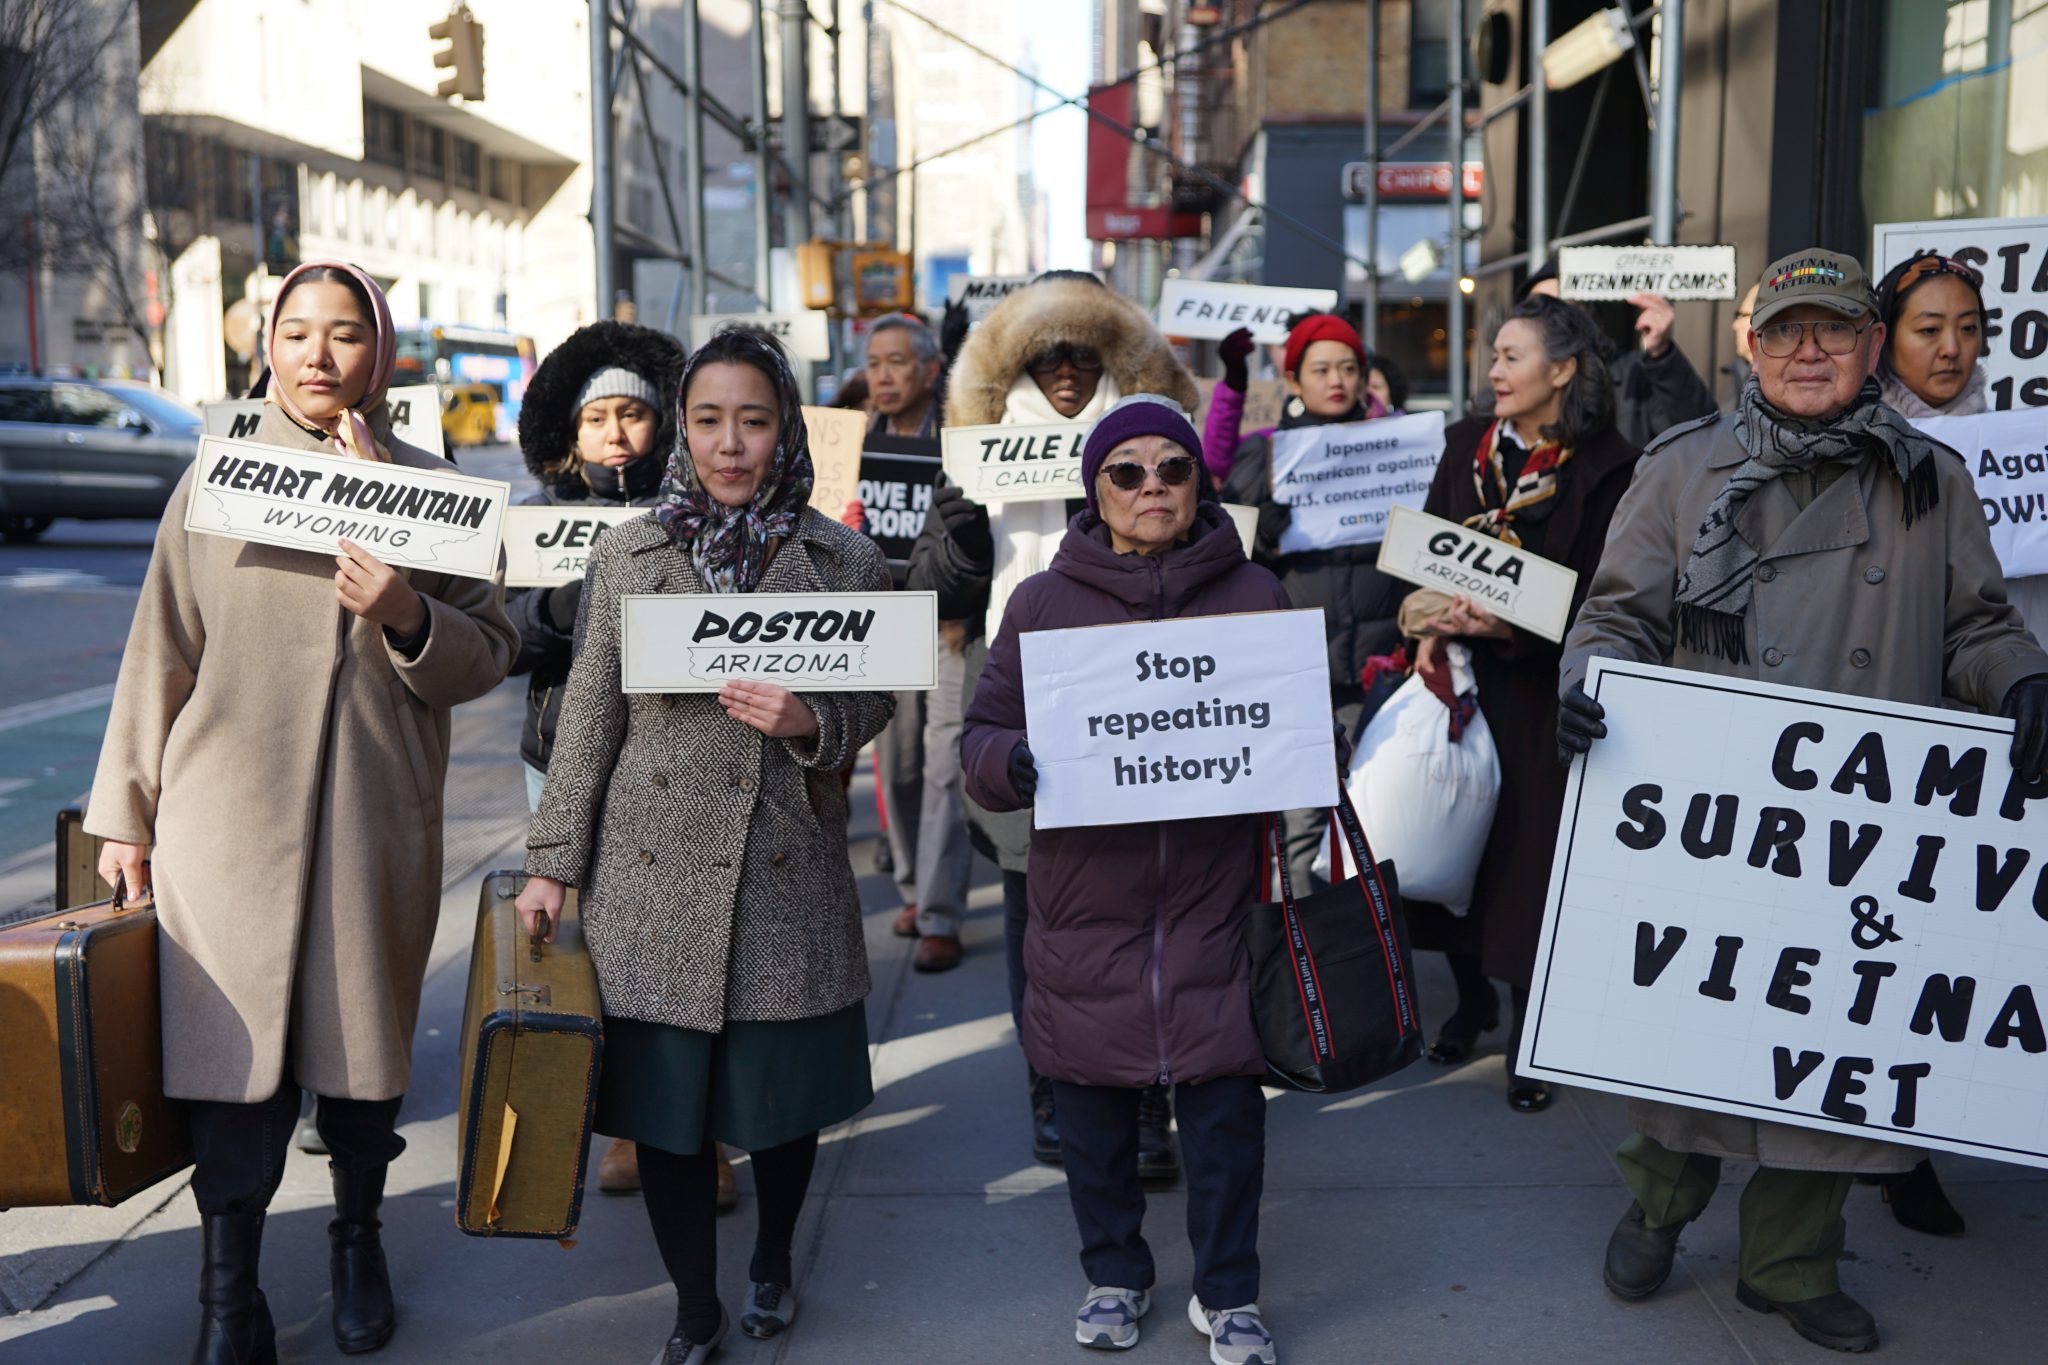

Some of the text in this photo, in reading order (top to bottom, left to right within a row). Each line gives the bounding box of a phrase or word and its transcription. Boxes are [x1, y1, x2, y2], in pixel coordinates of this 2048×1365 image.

[1616, 253, 1674, 267] OTHER
[1777, 258, 1838, 275] VIETNAM
[1567, 272, 1728, 291] INTERNMENT CAMPS
[1775, 276, 1838, 293] VETERAN
[980, 435, 1062, 463] TULE
[1325, 437, 1399, 458] Japanese
[1286, 454, 1437, 485] Americans against
[207, 455, 492, 529] HEART MOUNTAIN
[1289, 493, 1319, 507] U.S.
[263, 508, 411, 547] WYOMING
[1340, 510, 1391, 527] camp
[1428, 531, 1524, 586] GILA
[1424, 562, 1510, 605] ARIZONA
[691, 609, 876, 643] POSTON
[706, 654, 849, 673] ARIZONA
[1136, 650, 1216, 683] Stop
[1088, 698, 1270, 740] repeating
[1114, 747, 1252, 786] history!
[1351, 831, 1372, 874] THIRTEEN
[1616, 783, 2048, 922] SURVIV
[1368, 879, 1387, 923] THIRTEEN
[1850, 894, 1903, 950] &
[1287, 904, 1302, 949] THIRTEEN
[1299, 955, 1317, 1002] THIRTEEN
[1312, 1008, 1328, 1055] THIRTEEN
[1772, 1046, 1931, 1128] VET
